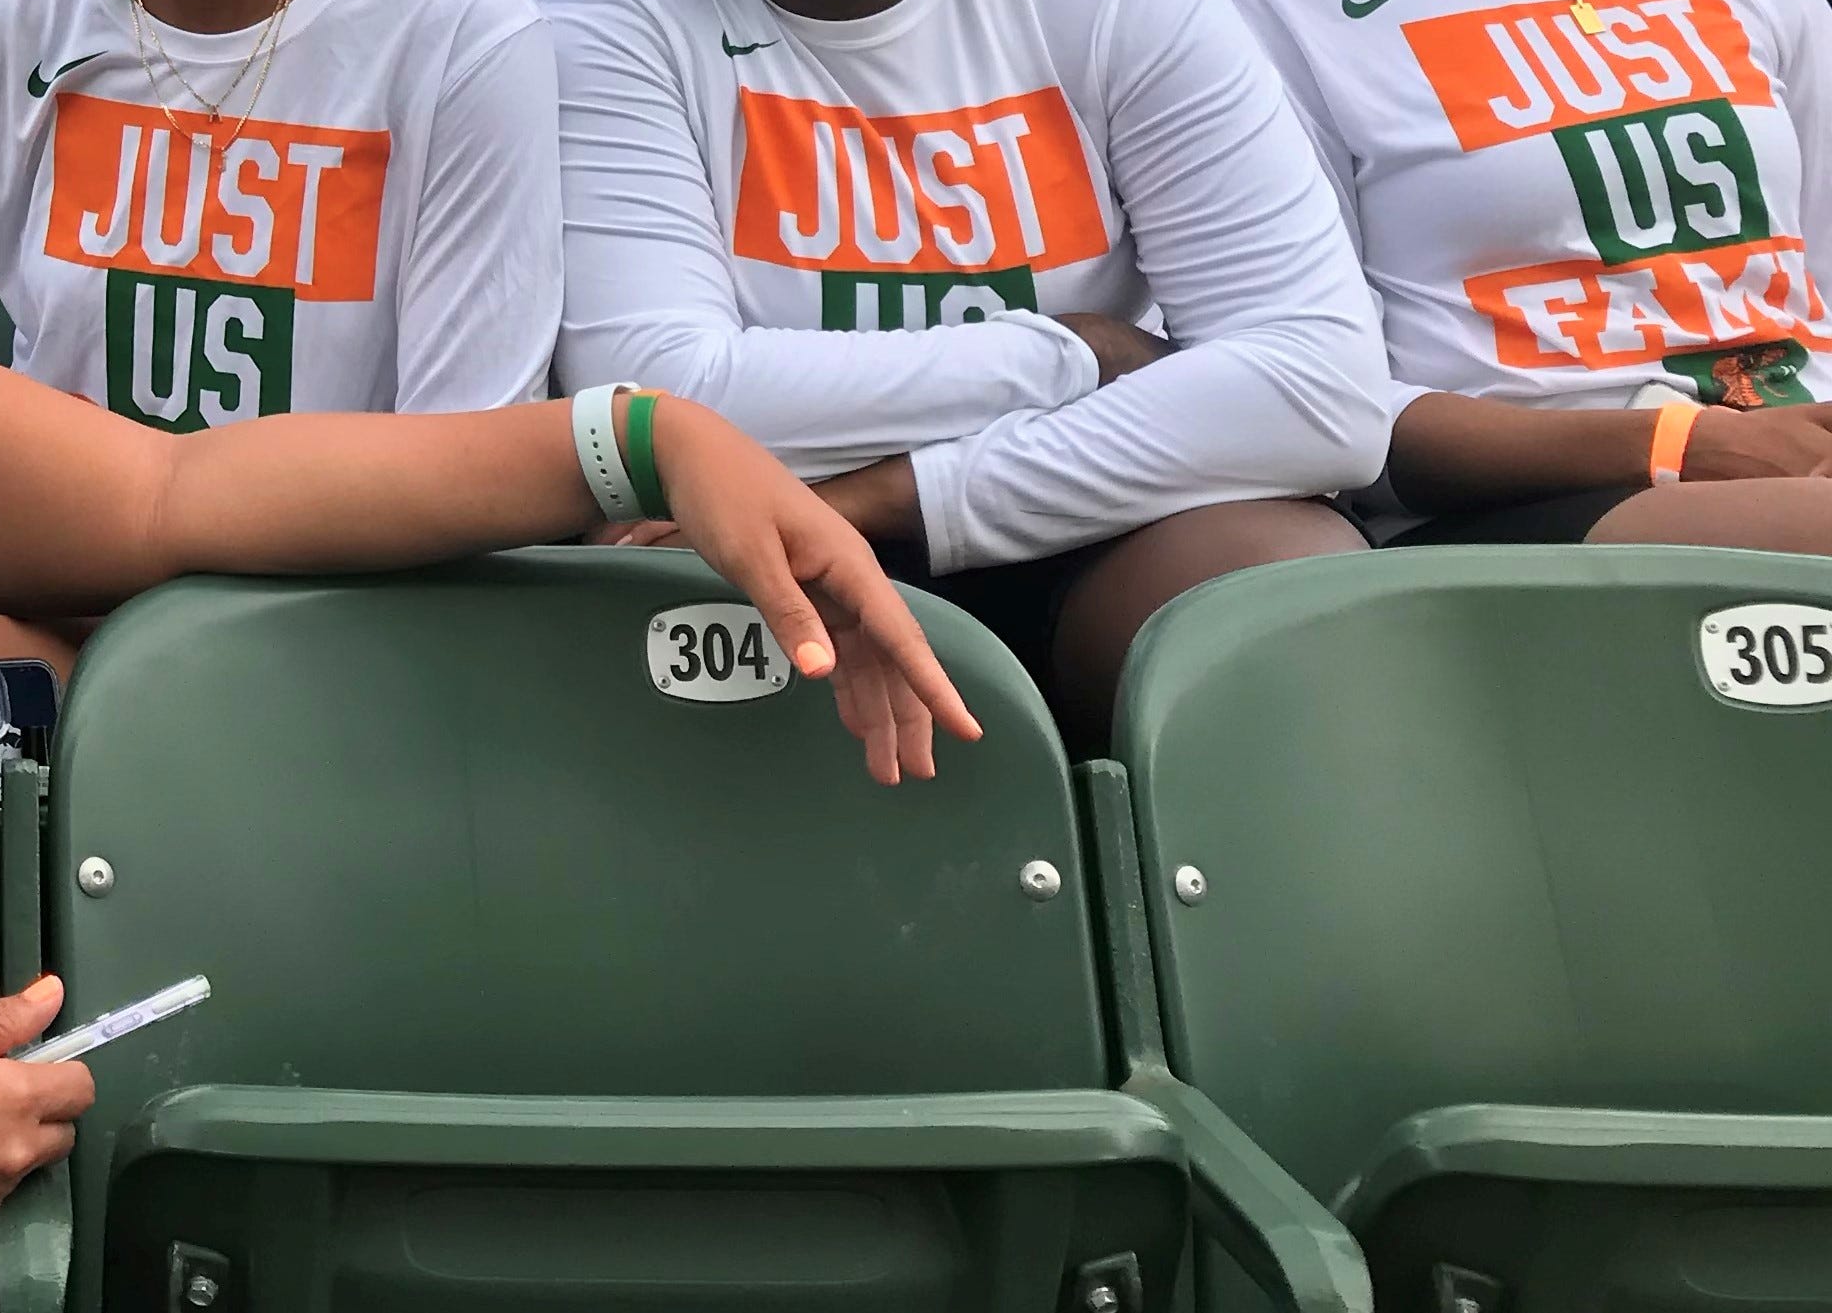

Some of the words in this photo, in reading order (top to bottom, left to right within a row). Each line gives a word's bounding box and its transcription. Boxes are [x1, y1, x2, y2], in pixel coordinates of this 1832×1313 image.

[78, 124, 345, 286] JUST
[778, 112, 1047, 267] JUST
[1584, 112, 1742, 250] US
[132, 282, 265, 430] US
[1503, 250, 1832, 358] FAMU
[669, 622, 770, 682] 304
[1725, 624, 1832, 686] 305
